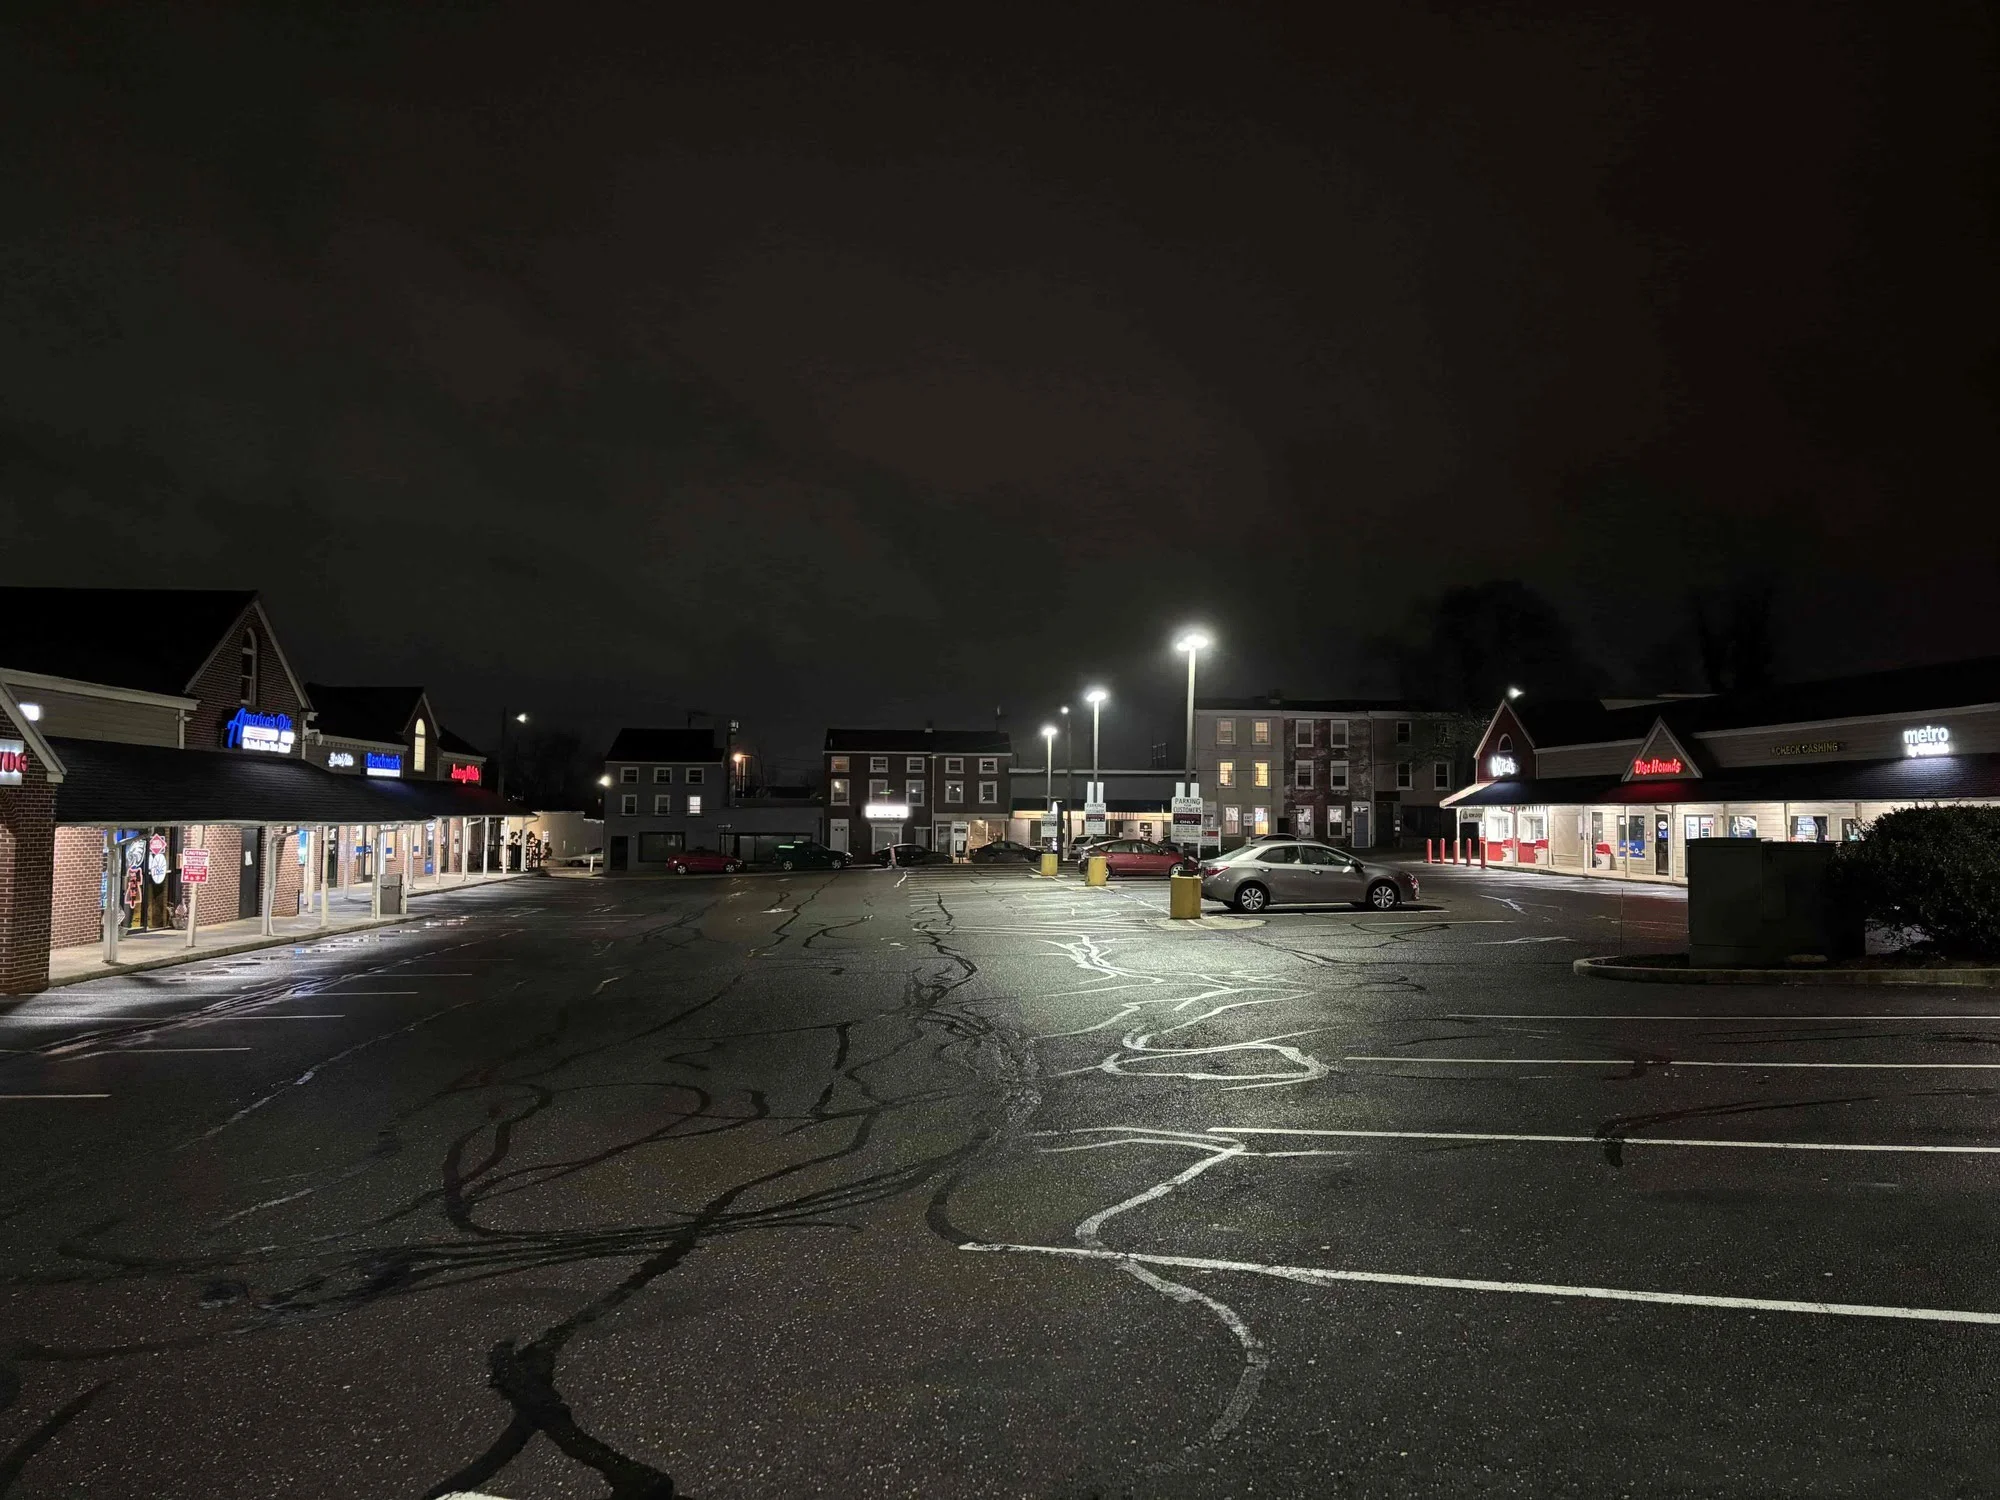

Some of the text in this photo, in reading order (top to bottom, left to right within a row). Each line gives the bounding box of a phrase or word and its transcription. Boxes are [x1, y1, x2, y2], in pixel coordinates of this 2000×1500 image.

[227, 707, 275, 749] America's
[276, 713, 293, 730] Pie
[1903, 725, 1949, 744] metro
[1775, 741, 1838, 756] CHECK CASHING
[1651, 758, 1681, 774] Hounds
